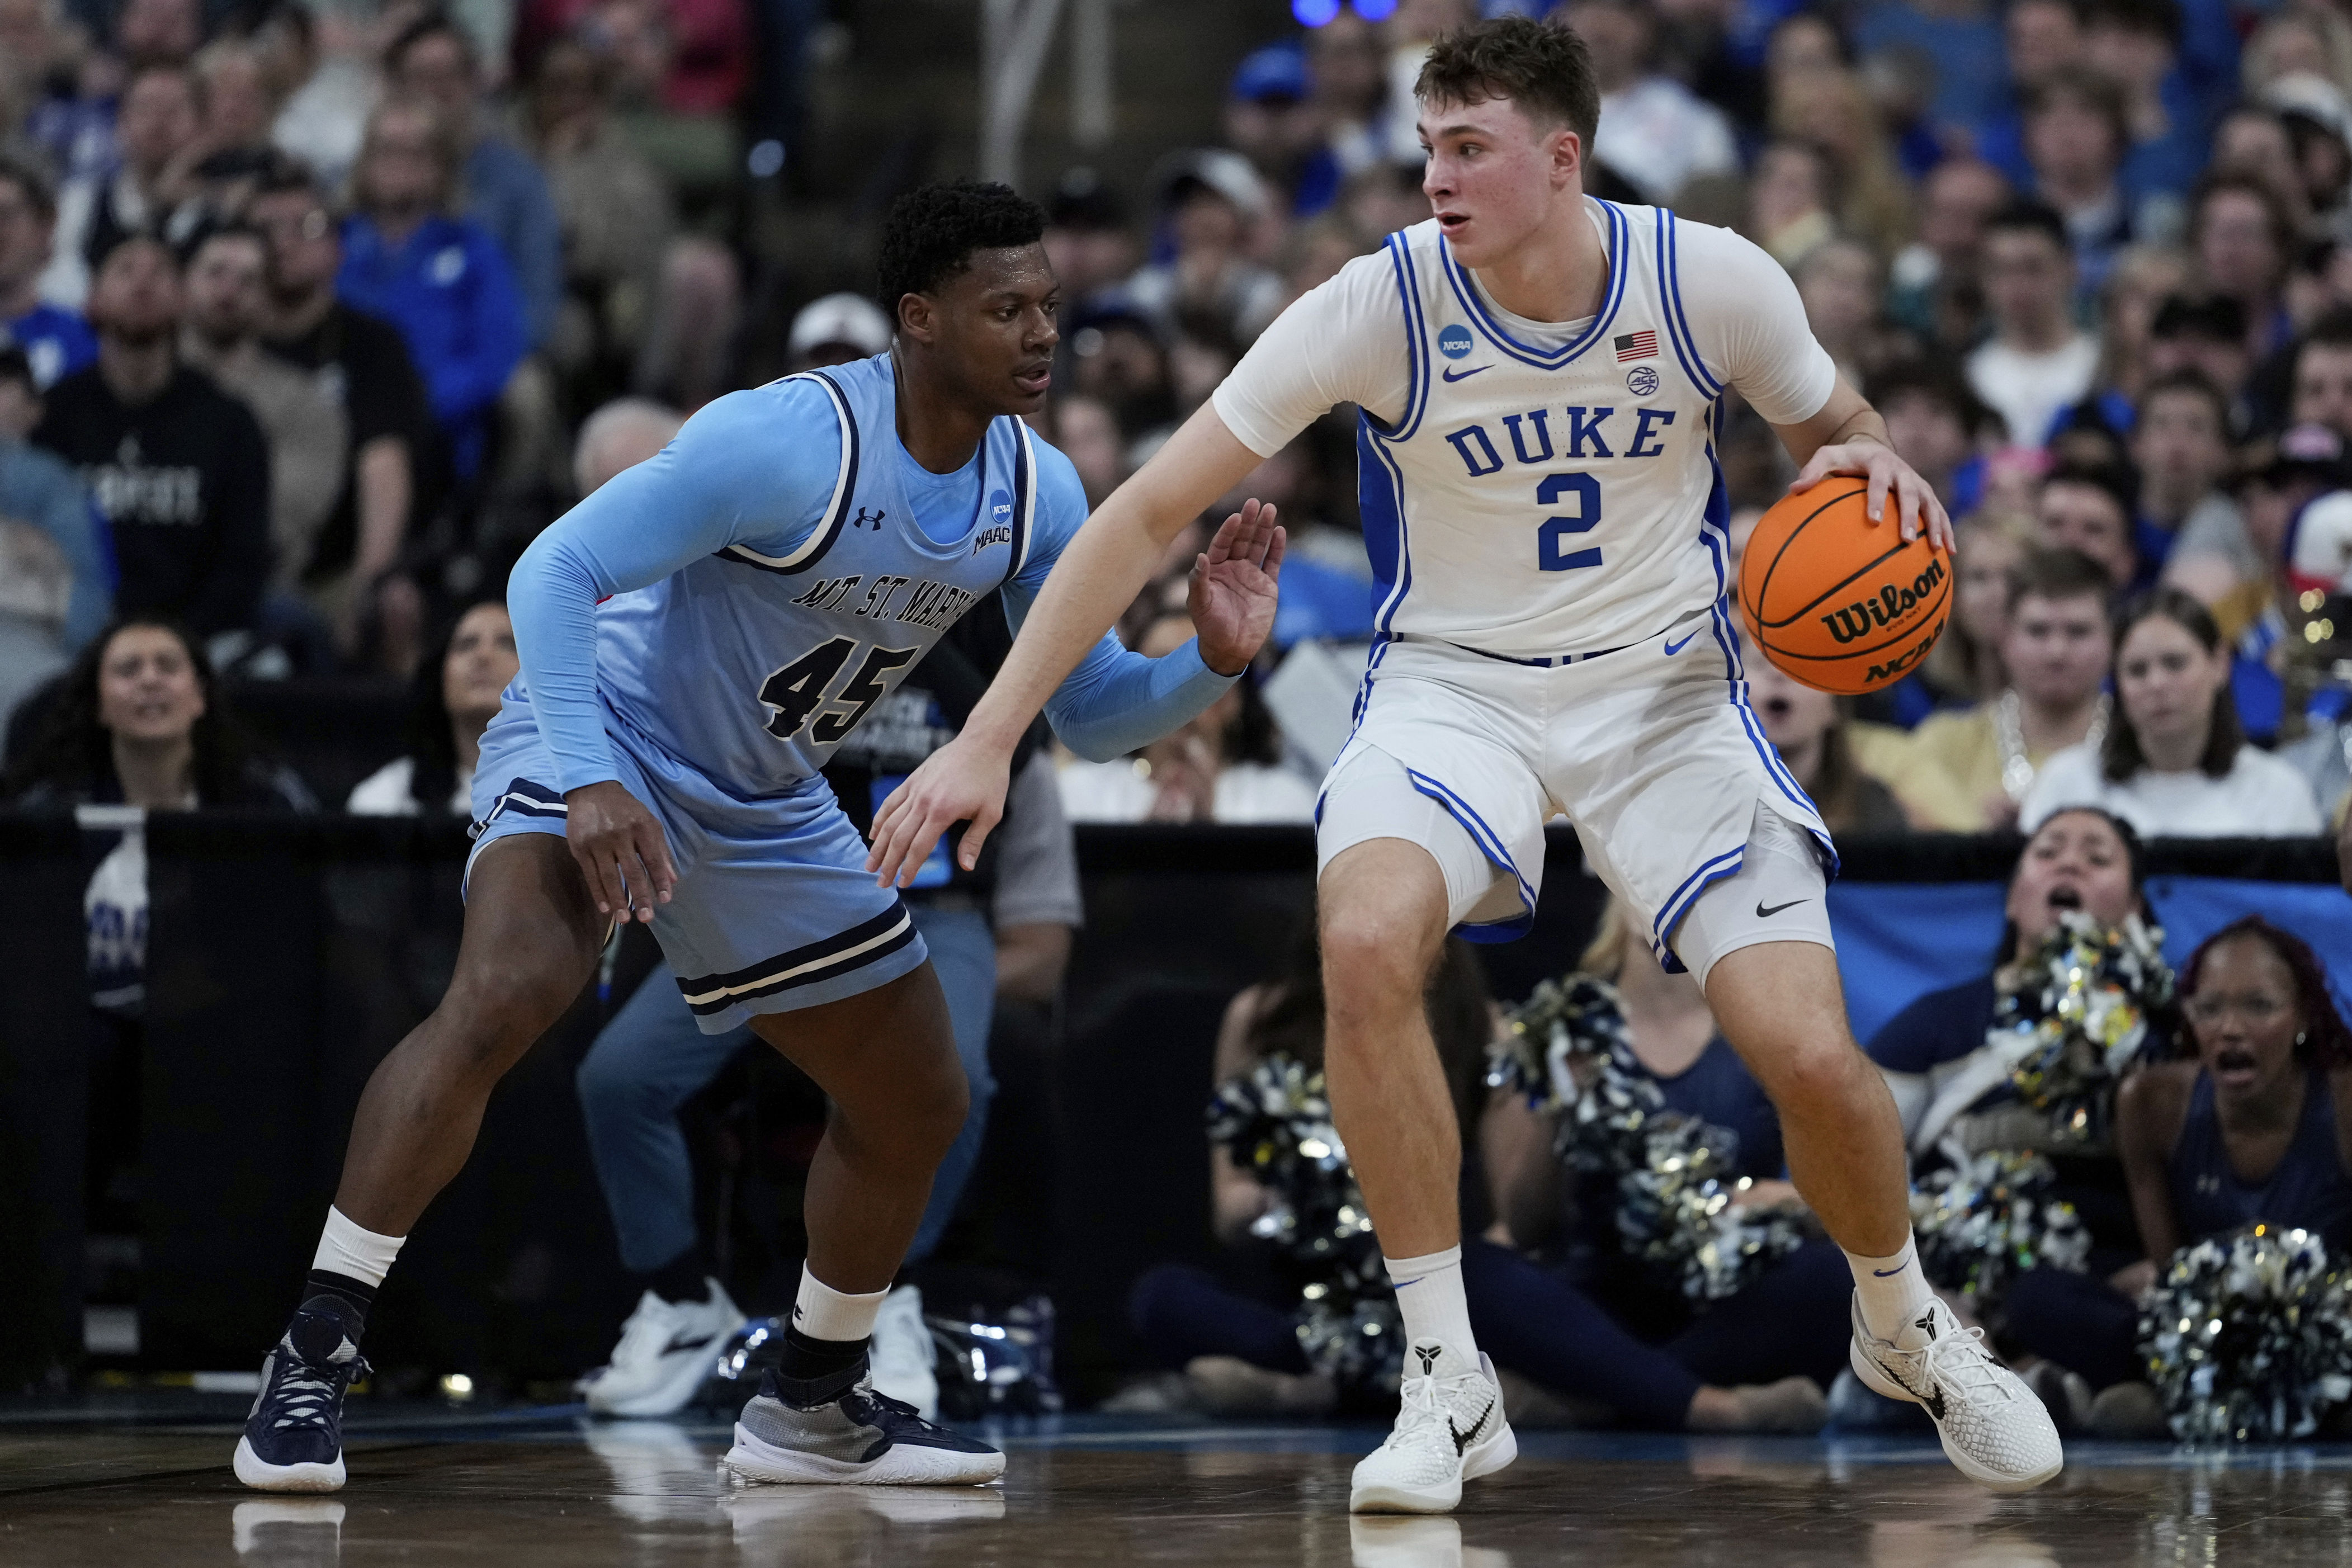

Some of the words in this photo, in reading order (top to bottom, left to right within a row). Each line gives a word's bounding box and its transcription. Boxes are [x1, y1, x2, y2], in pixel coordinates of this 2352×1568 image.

[1443, 341, 1471, 351] NCAA
[1631, 374, 1656, 384] ACC
[1446, 407, 1675, 477] DUKE
[993, 504, 1011, 515] NCAA
[1536, 471, 1603, 572] 2
[971, 526, 1011, 559] MAAC
[790, 574, 863, 613] MT.
[858, 574, 911, 621] ST.
[1820, 558, 1945, 644] Wilson
[1864, 617, 1945, 683] NCAA
[758, 634, 922, 745] 45
